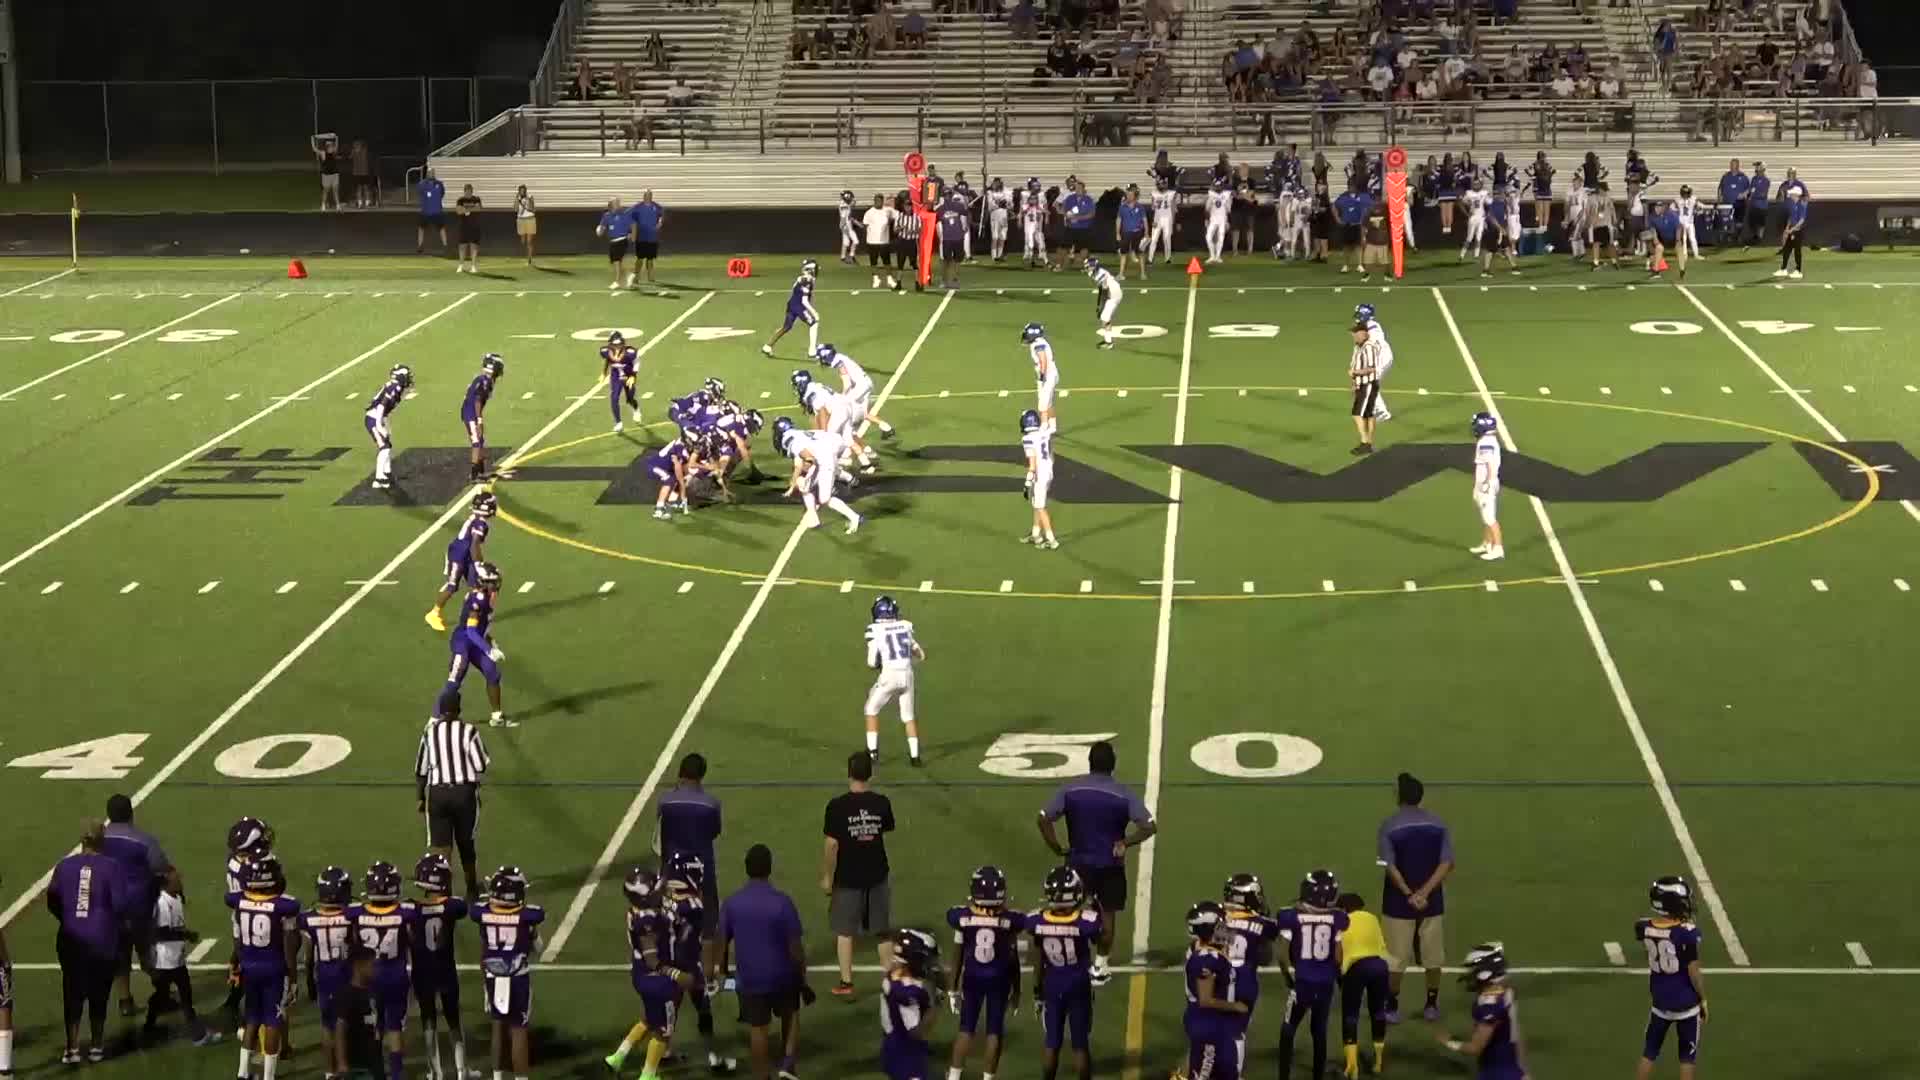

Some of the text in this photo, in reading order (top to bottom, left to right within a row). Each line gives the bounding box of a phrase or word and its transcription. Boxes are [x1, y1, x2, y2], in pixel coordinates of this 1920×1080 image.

[730, 259, 746, 275] 40
[885, 631, 909, 660] 15
[6, 733, 352, 779] 40
[979, 732, 1323, 778] 50
[240, 912, 271, 948] 19
[486, 926, 517, 951] 17
[974, 928, 996, 964] 8
[1301, 924, 1331, 960] 18
